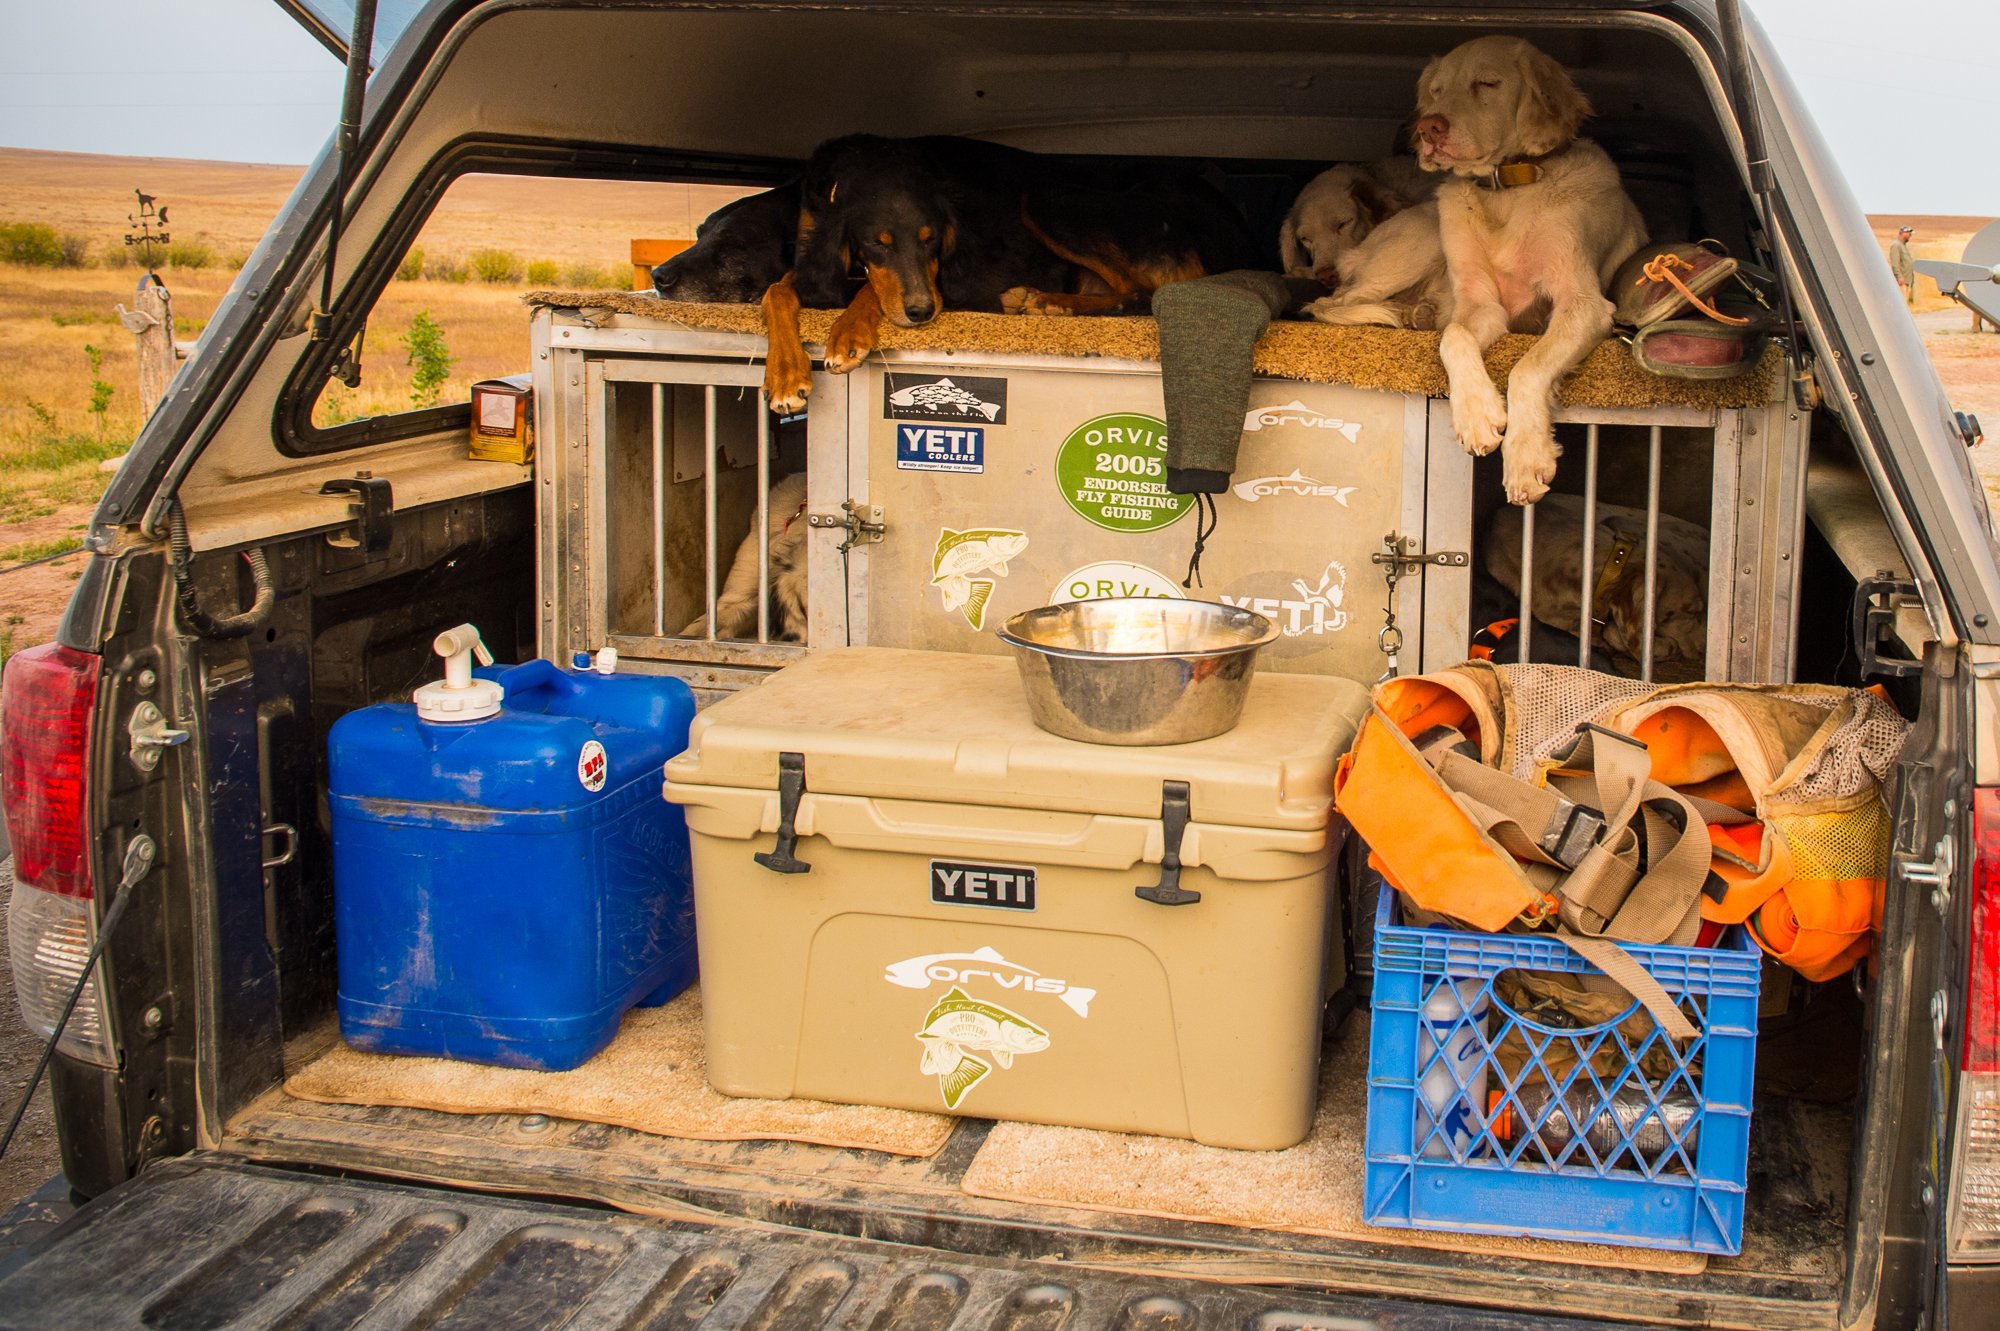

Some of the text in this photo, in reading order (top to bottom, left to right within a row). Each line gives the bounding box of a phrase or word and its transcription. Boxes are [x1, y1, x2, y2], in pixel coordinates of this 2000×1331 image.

[902, 428, 976, 455] YETI
[1084, 427, 1168, 452] ORVIS
[928, 453, 976, 462] COOLERS
[1095, 453, 1162, 476] 2005
[1076, 490, 1179, 510] FLY FISHING
[1101, 505, 1152, 521] GUIDE
[1069, 580, 1171, 598] ORVI
[584, 752, 605, 778] BPA
[935, 869, 1026, 902] YETI
[959, 1013, 976, 1022] PRO
